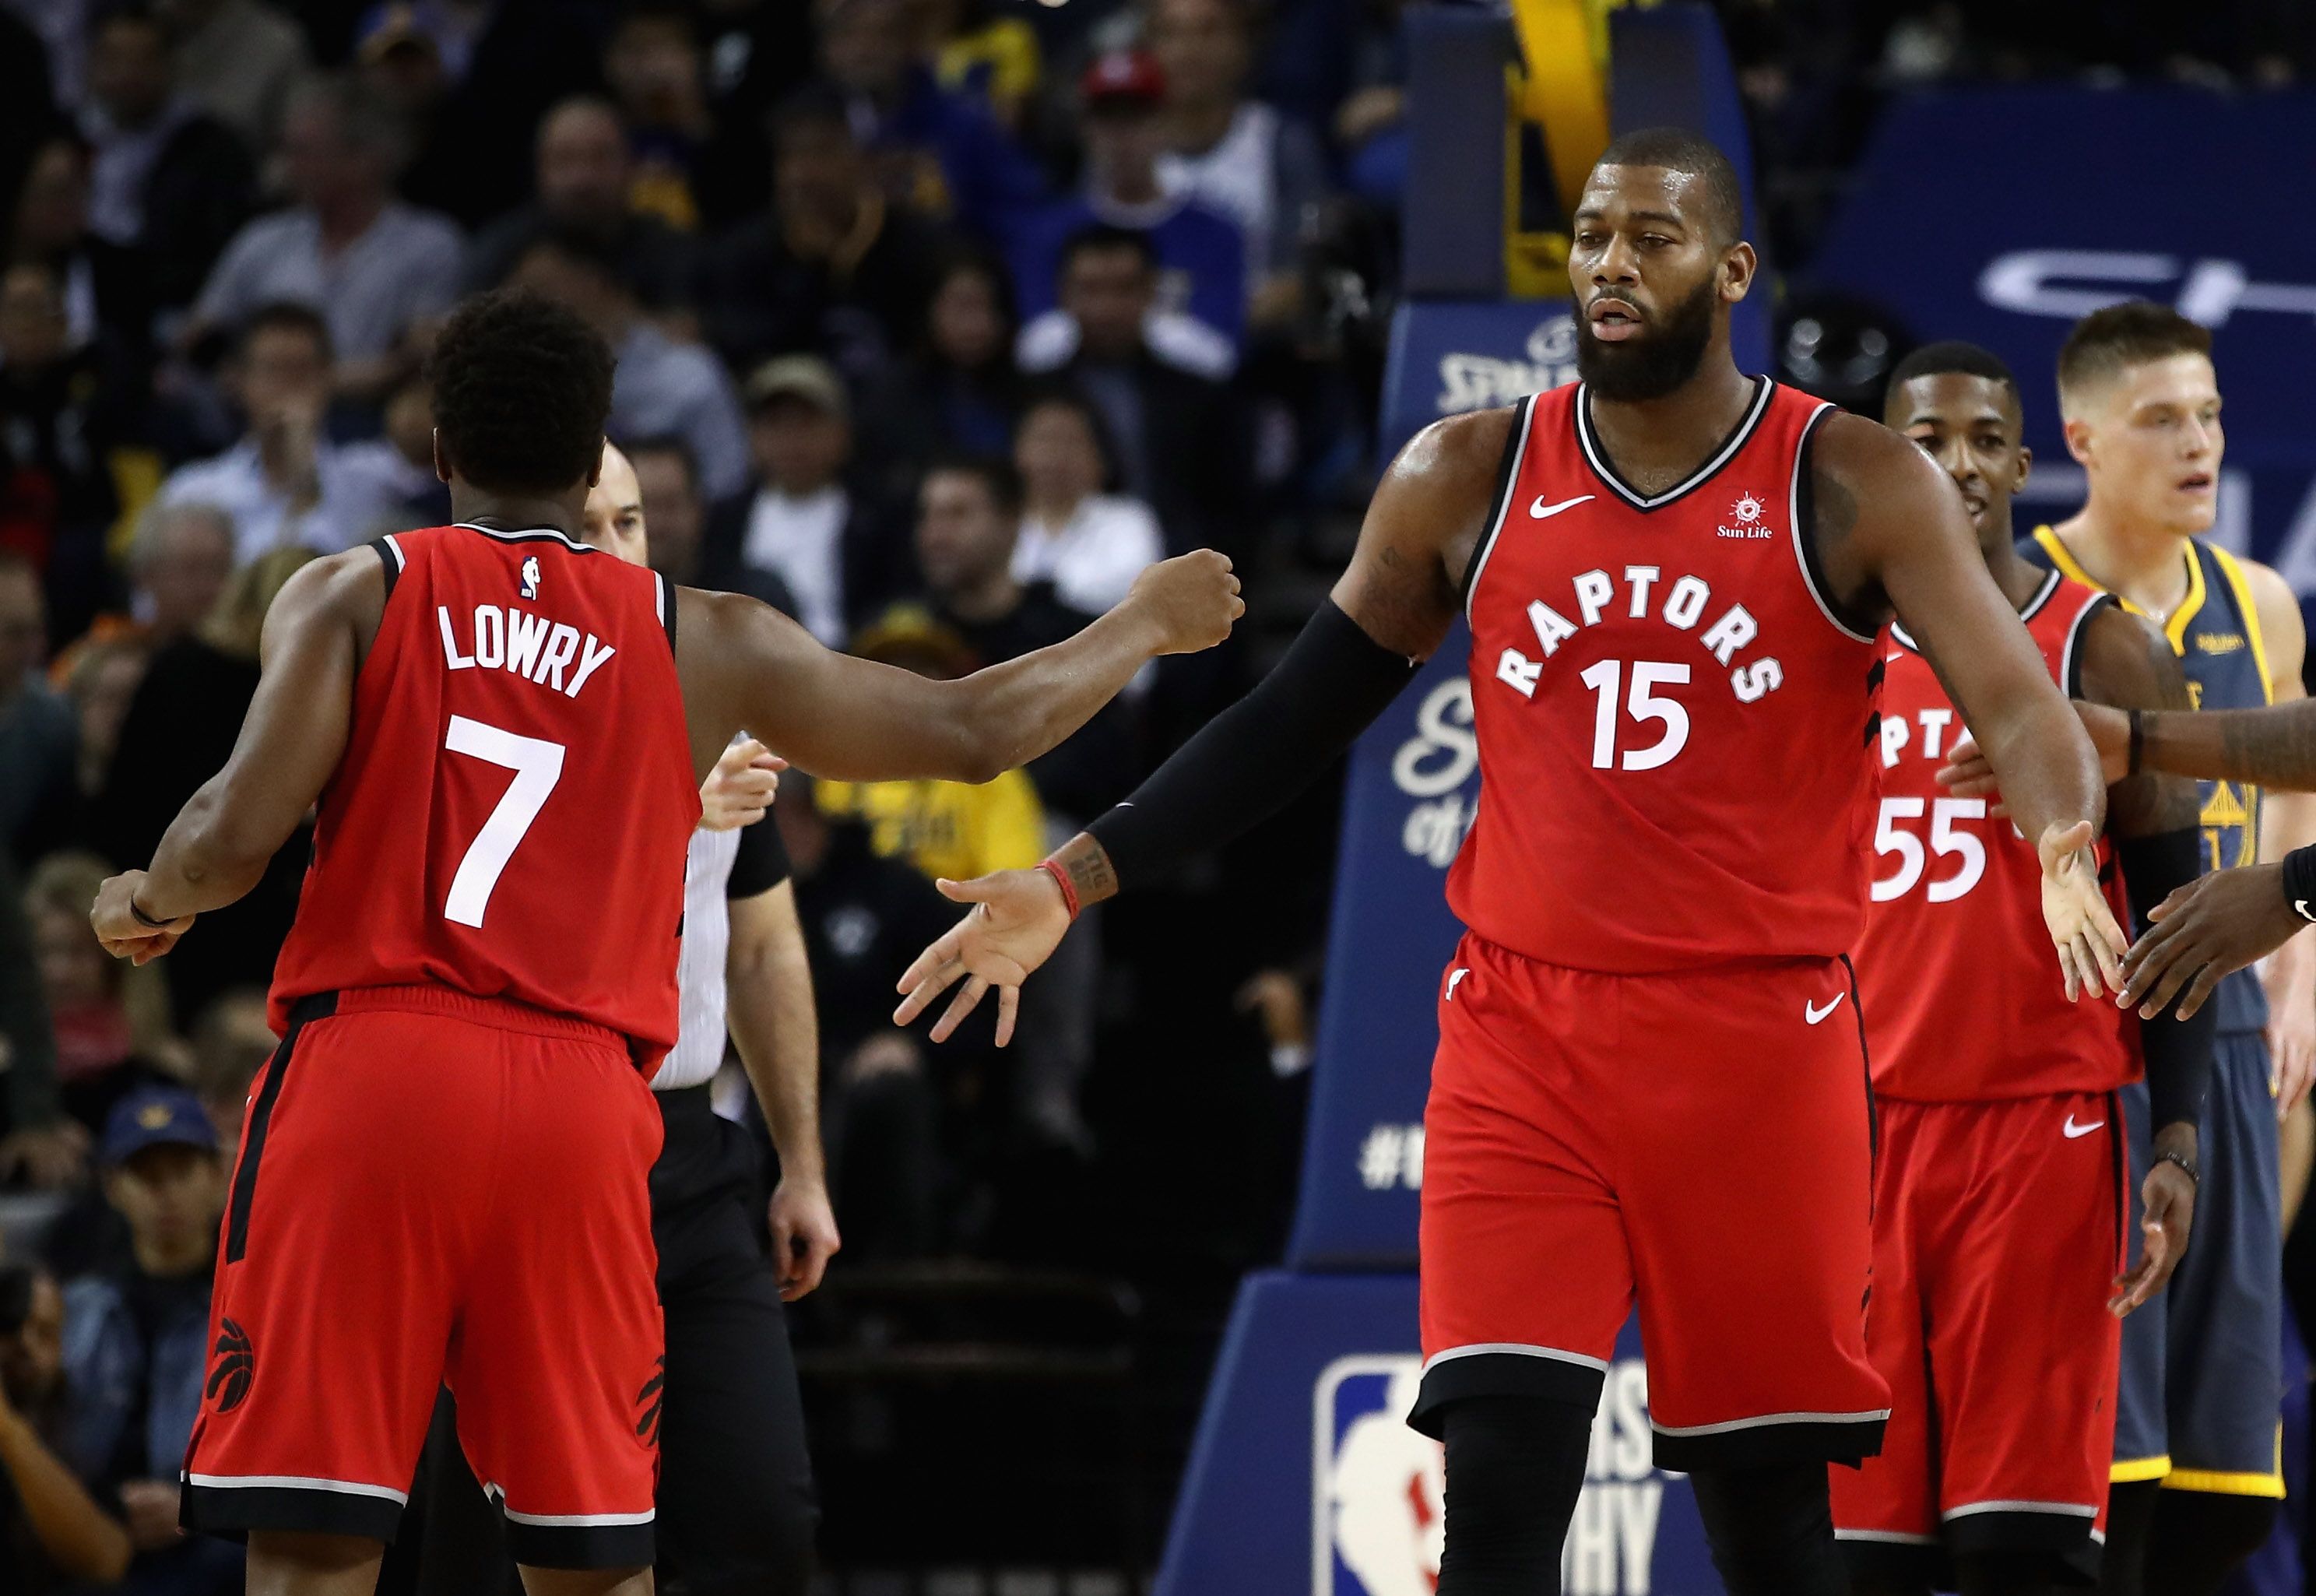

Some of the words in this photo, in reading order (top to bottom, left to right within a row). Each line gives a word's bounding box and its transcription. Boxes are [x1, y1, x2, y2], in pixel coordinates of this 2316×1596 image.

[1717, 525, 1744, 538] Sun
[1747, 526, 1773, 539] Life
[438, 604, 616, 698] LOWRY
[1495, 564, 1784, 705] RAPTORS
[1580, 659, 1691, 771] 15
[1880, 708, 1973, 769] PT
[445, 714, 566, 929] 7
[1871, 796, 1987, 903] 55
[1562, 1480, 1664, 1596] HY
